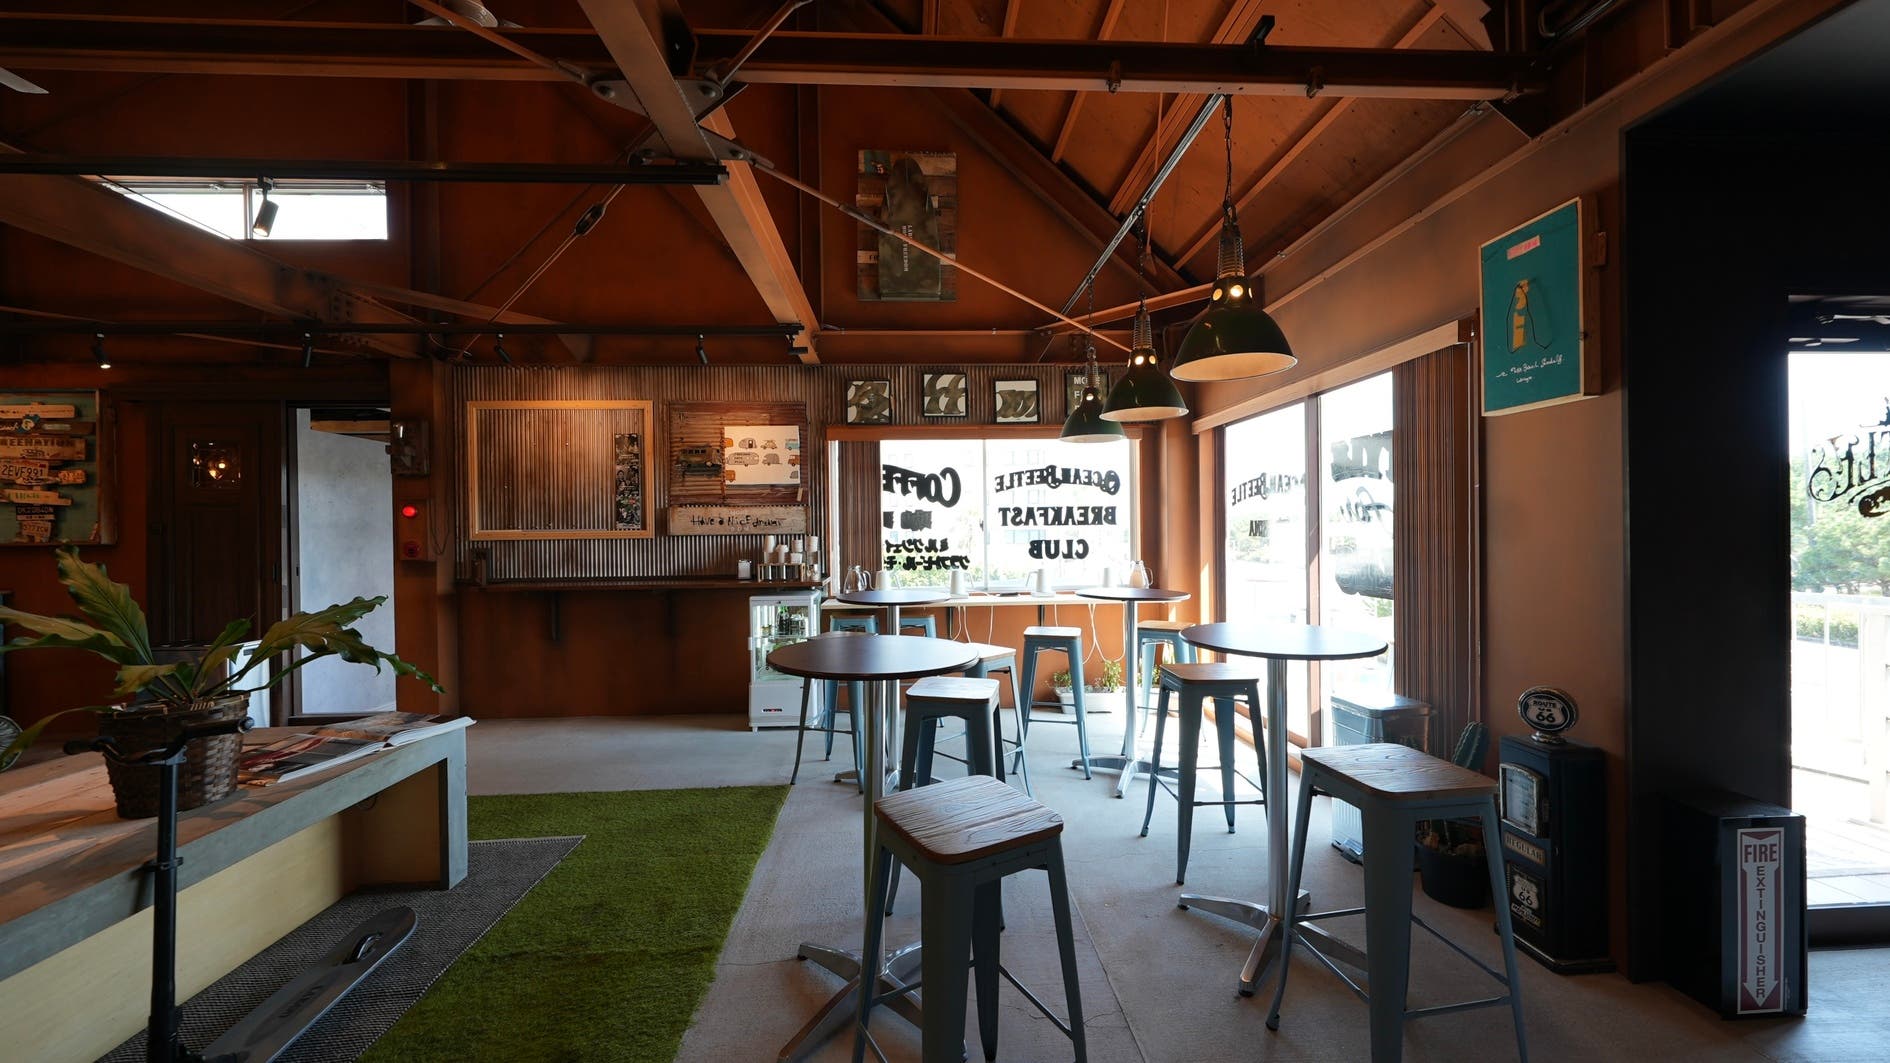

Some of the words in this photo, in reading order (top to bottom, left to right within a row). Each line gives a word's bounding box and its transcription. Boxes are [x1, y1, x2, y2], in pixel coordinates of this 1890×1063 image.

[690, 515, 714, 527] Have
[1532, 700, 1556, 708] ROUTE
[1536, 712, 1556, 723] 66
[1744, 844, 1778, 863] FIRE
[1519, 891, 1533, 906] 66
[1755, 866, 1767, 999] EXTINGUISHER
